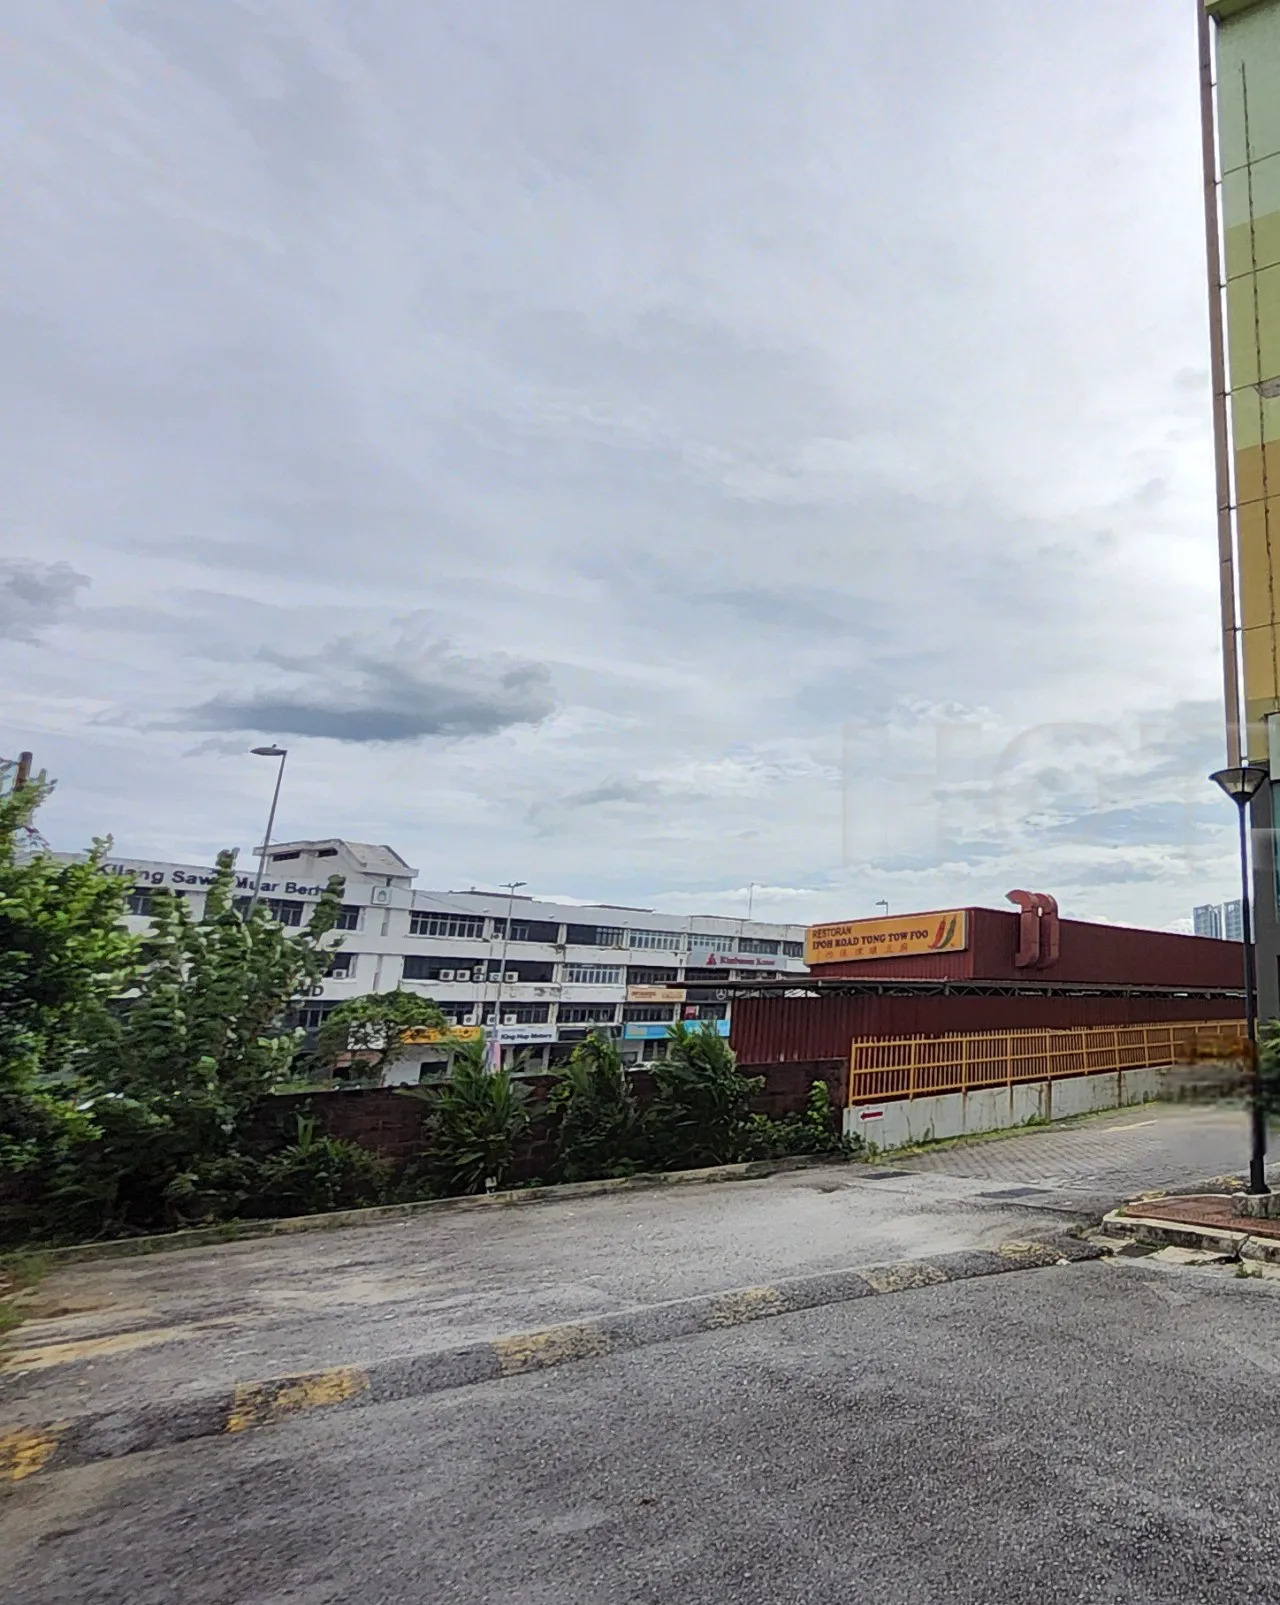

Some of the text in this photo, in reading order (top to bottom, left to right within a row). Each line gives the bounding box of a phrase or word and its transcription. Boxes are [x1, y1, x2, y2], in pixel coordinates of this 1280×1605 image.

[171, 870, 218, 886] Saw
[284, 881, 325, 897] Berh
[812, 926, 853, 939] RESTORAN
[834, 936, 859, 948] ROAD
[861, 934, 886, 945] YONG
[887, 931, 909, 942] TOW
[910, 929, 929, 940] FOO
